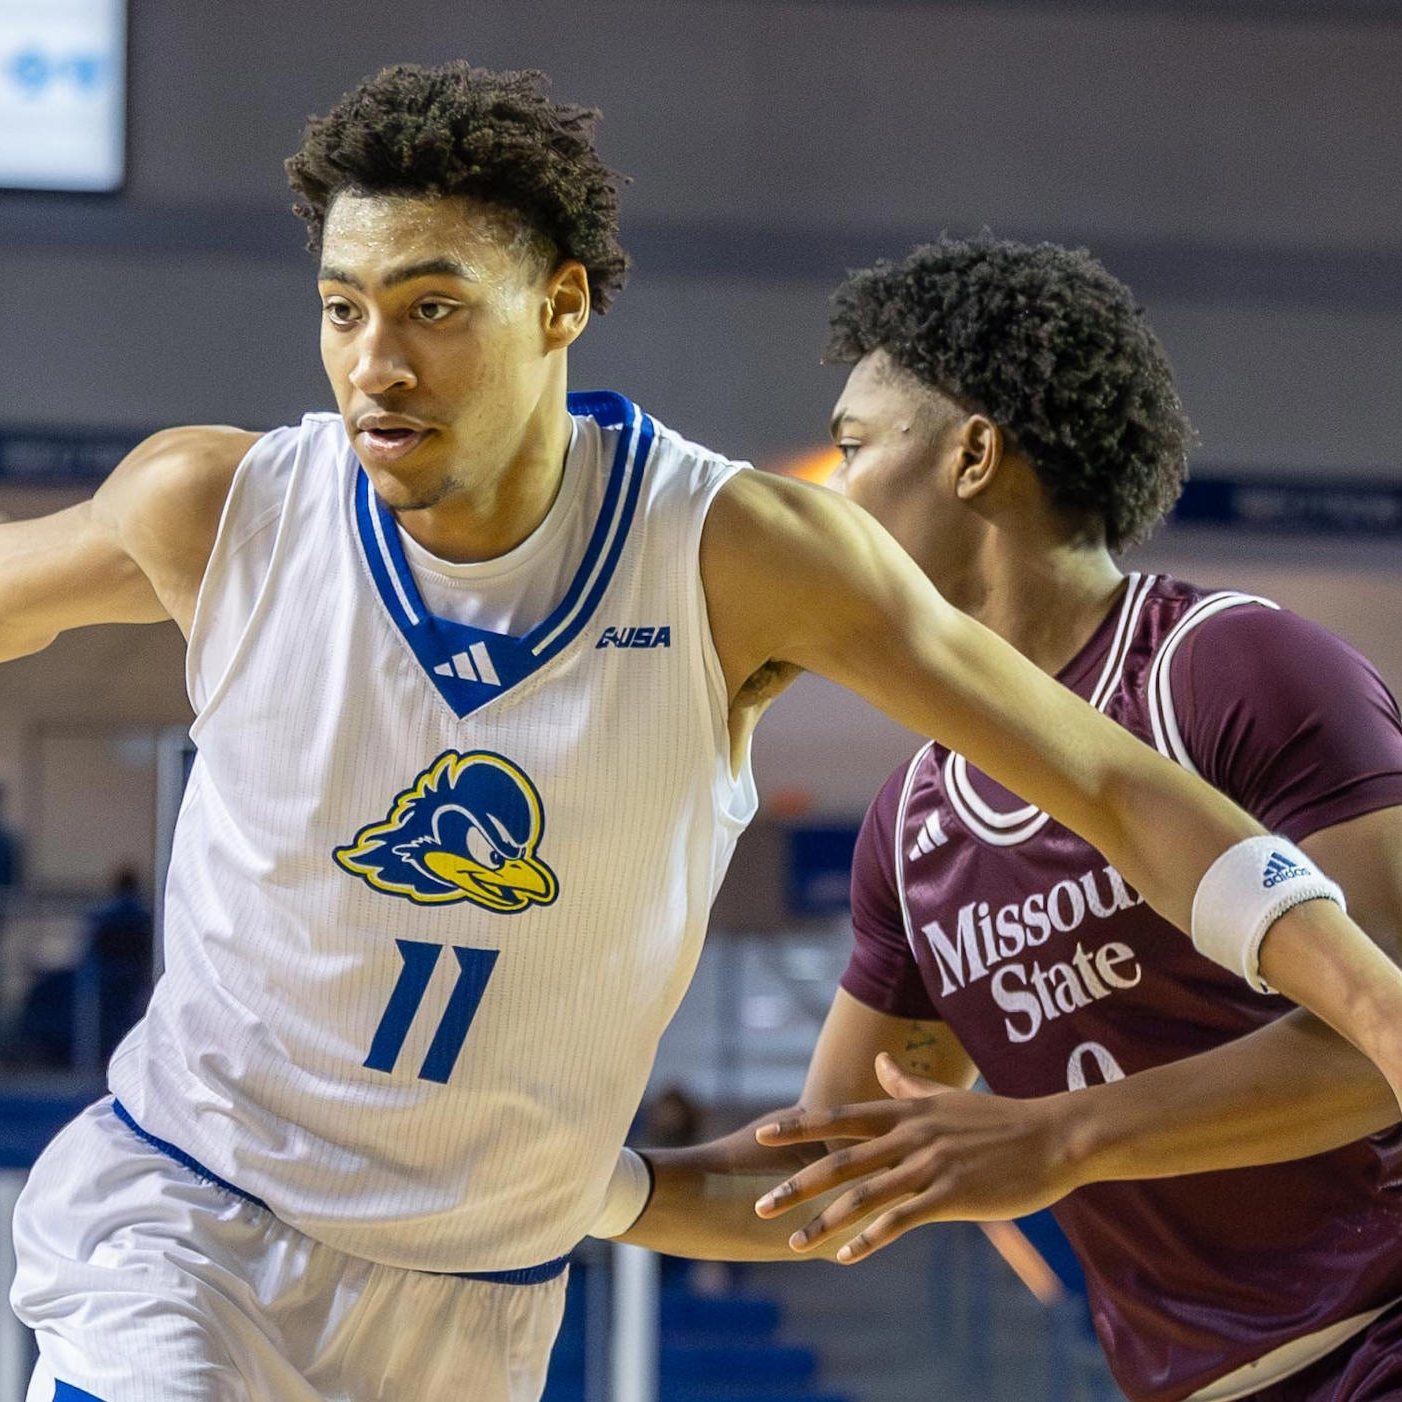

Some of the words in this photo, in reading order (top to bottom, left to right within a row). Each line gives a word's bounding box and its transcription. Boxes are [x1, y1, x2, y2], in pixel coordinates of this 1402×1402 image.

[922, 866, 1146, 998] Missou
[1262, 868, 1311, 888] adidas
[362, 938, 501, 1085] 11
[991, 941, 1142, 1043] State
